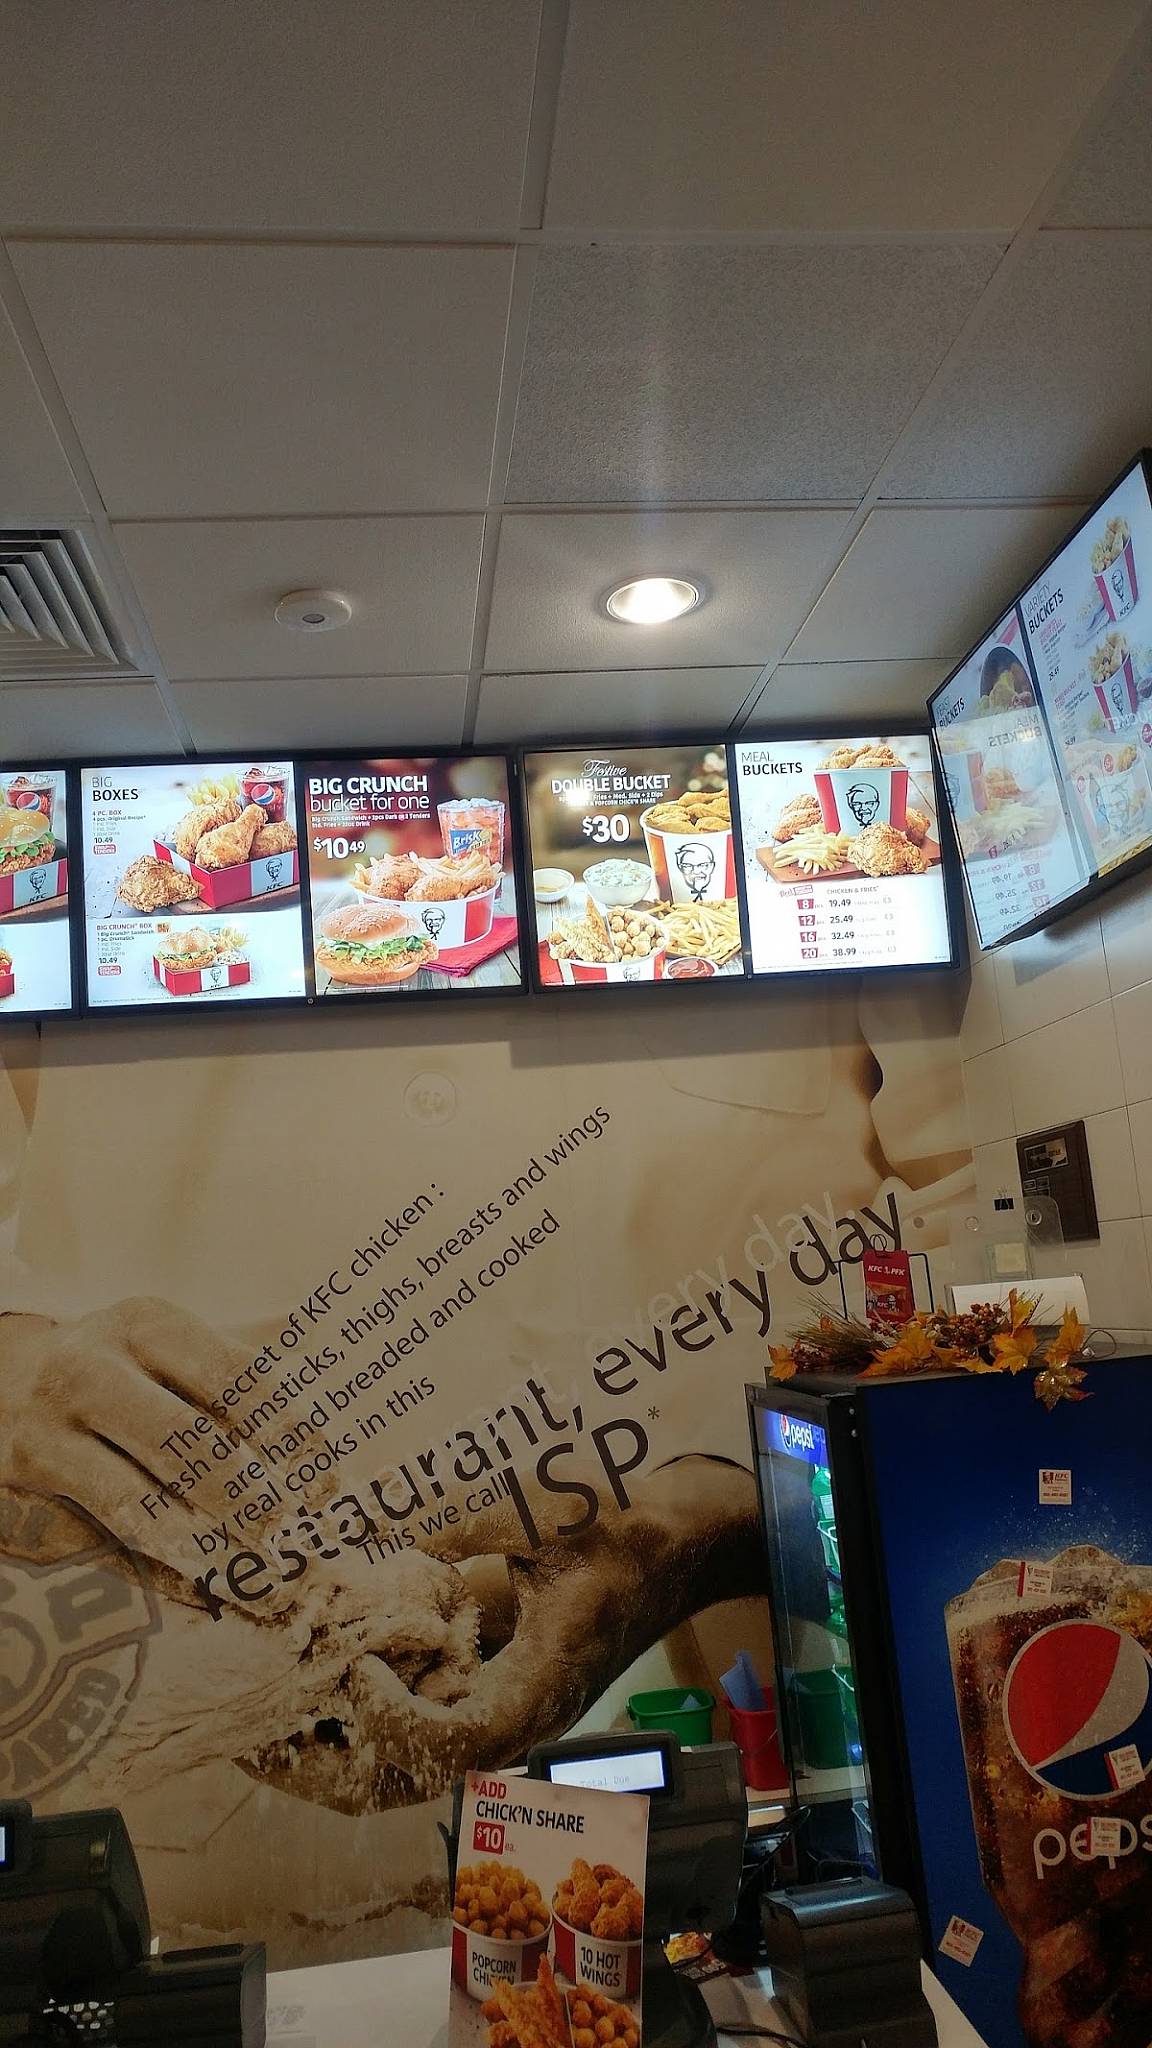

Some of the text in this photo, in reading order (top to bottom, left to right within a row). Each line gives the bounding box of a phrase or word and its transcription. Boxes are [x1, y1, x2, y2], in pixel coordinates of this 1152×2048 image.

[1029, 588, 1063, 634] BUCKETS
[741, 751, 774, 763] MEAL
[581, 759, 627, 778] Festive
[743, 762, 803, 776] BUCKETS
[92, 776, 112, 788] BIG
[309, 775, 428, 795] BIG CRUNCH
[551, 774, 671, 794] DOUBLE BUCKET
[93, 788, 138, 801] BOXES
[310, 793, 430, 812] bucket for one
[582, 813, 630, 843] $30
[94, 836, 113, 844] 10.49
[453, 830, 481, 850] Brisk
[266, 880, 284, 892] KFC
[802, 899, 809, 909] 8
[829, 899, 851, 907] 19.49
[800, 916, 814, 926] 12
[830, 915, 853, 924] 25.49
[802, 932, 815, 942] 16
[831, 931, 855, 940] 32.49
[803, 949, 817, 958] 20
[832, 947, 856, 957] 38.99
[868, 1265, 906, 1276] KFC PFK
[139, 1104, 611, 1521] Fresh drumsticks, thighs, breasts and wings
[877, 1300, 889, 1309] KFC
[222, 1207, 562, 1501] are hand breaded and cooked
[160, 1415, 213, 1461] The
[210, 1346, 283, 1418] secret
[279, 1309, 307, 1350] of
[299, 1270, 353, 1326] KFC
[193, 1191, 903, 1624] restaurant, every day
[790, 1423, 815, 1452] pepsi
[191, 1374, 437, 1558] by real cooks in this
[356, 1525, 417, 1566] This
[418, 1504, 461, 1537] we
[465, 1470, 513, 1514] call
[471, 1779, 507, 1800] +ADD
[613, 1775, 630, 1785] Due
[536, 1809, 585, 1834] SHARE
[476, 1825, 502, 1850] $10
[472, 1951, 517, 1974] POPCORN
[581, 1947, 621, 1970] 10 HOT
[580, 1961, 621, 1988] WINGS
